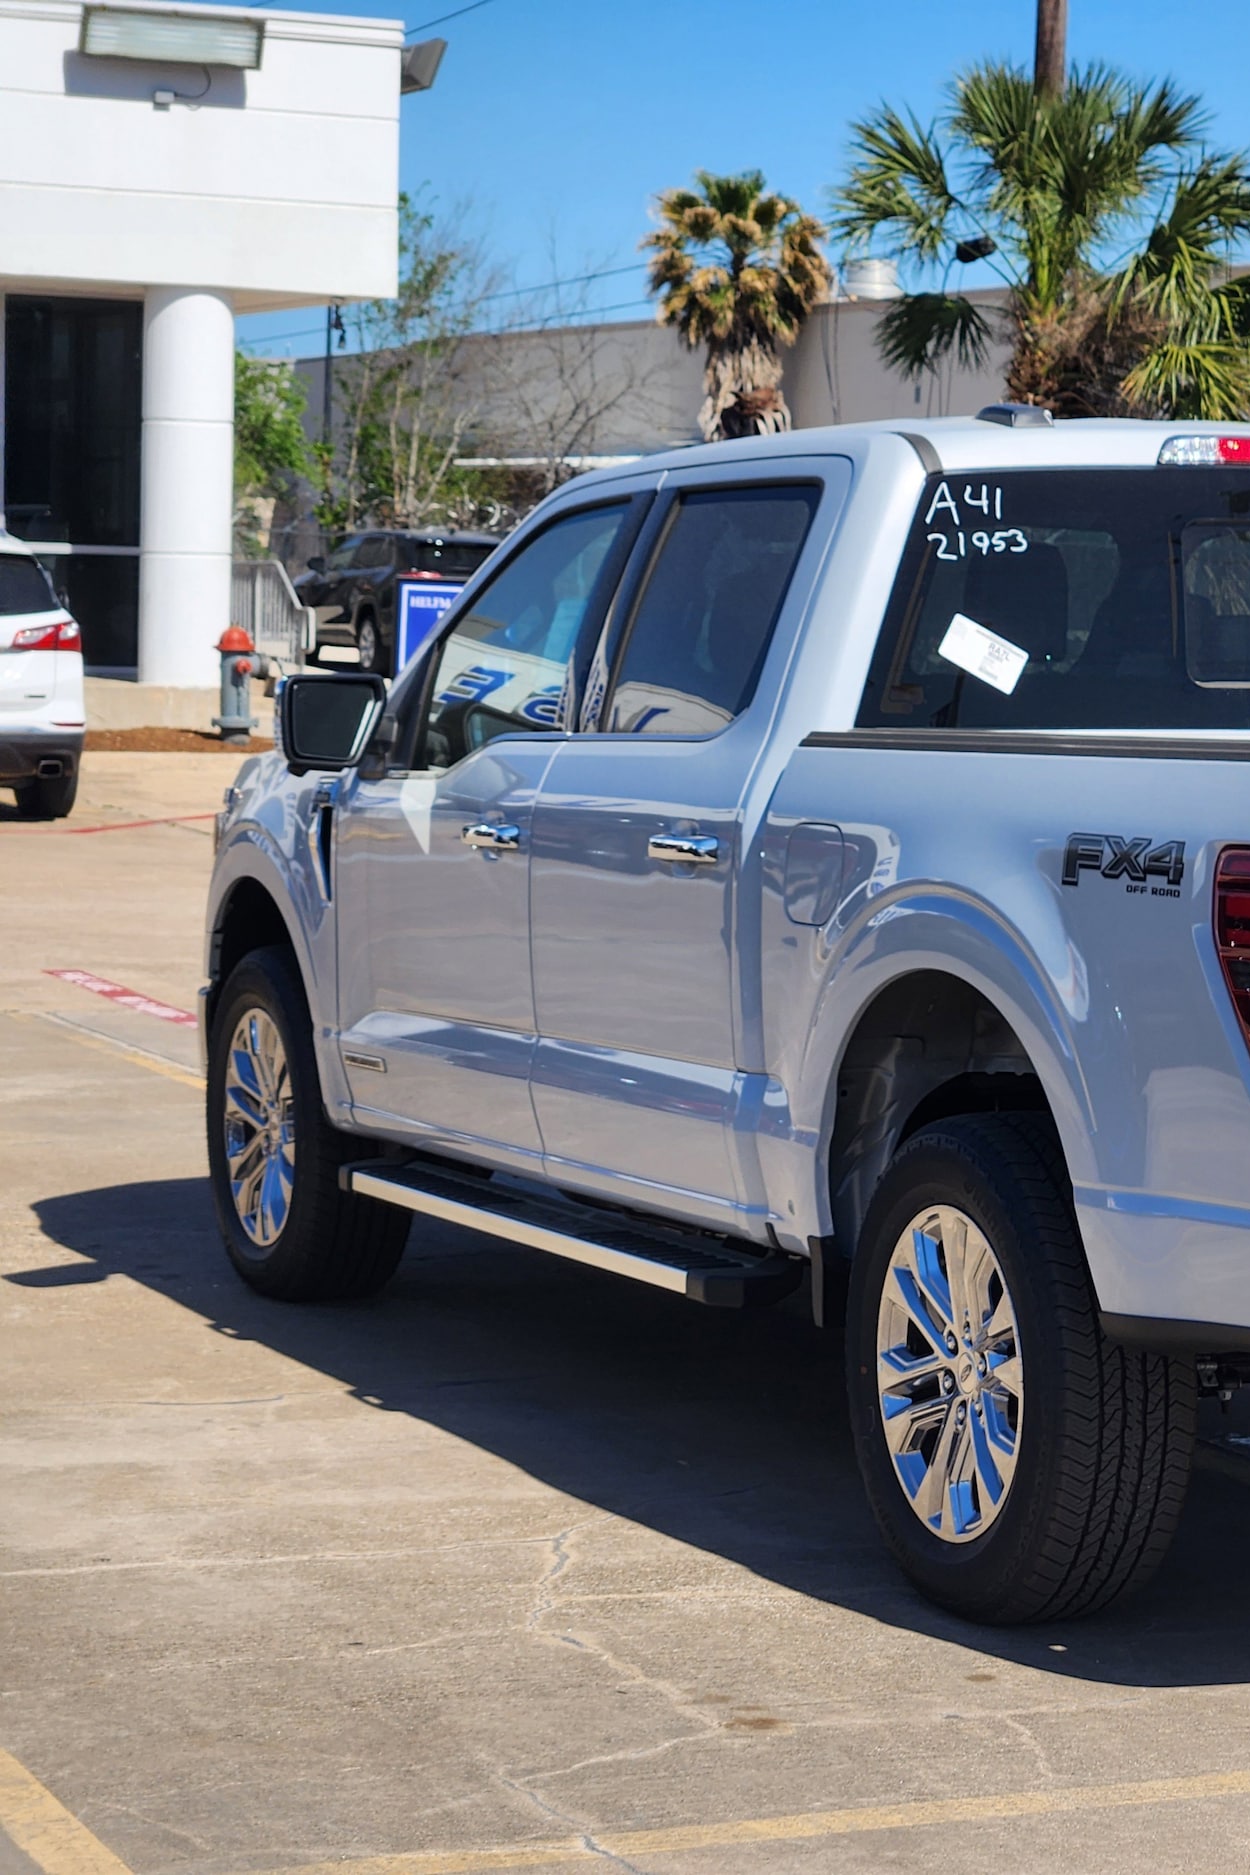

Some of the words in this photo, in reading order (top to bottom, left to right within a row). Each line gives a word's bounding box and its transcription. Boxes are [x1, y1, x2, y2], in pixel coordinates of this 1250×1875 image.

[926, 528, 1029, 561] 21953
[1061, 832, 1186, 887] FX4
[1126, 884, 1148, 894] OFF
[1151, 887, 1181, 898] ROAD
